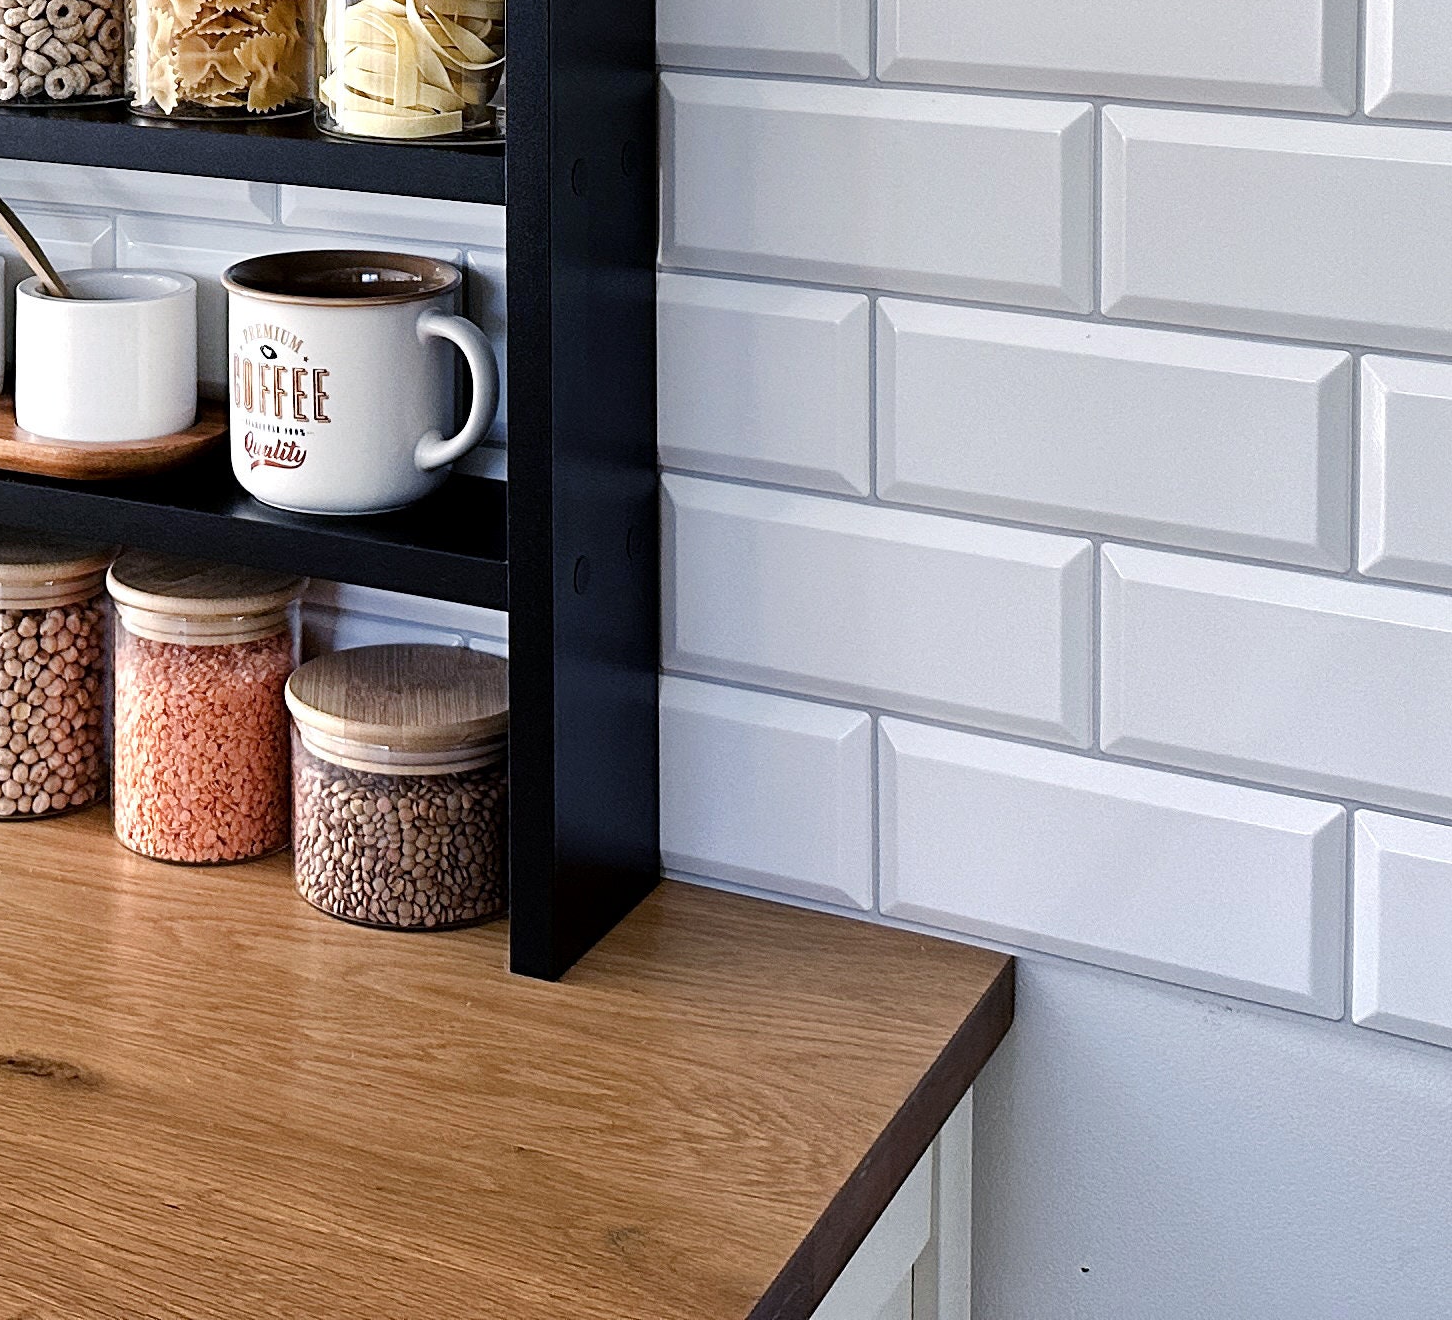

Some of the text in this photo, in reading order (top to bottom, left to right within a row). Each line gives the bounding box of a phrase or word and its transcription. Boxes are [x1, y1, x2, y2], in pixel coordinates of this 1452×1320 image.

[242, 323, 304, 353] PREMIUM
[234, 352, 332, 423] COFFEE
[245, 430, 307, 472] Quality
